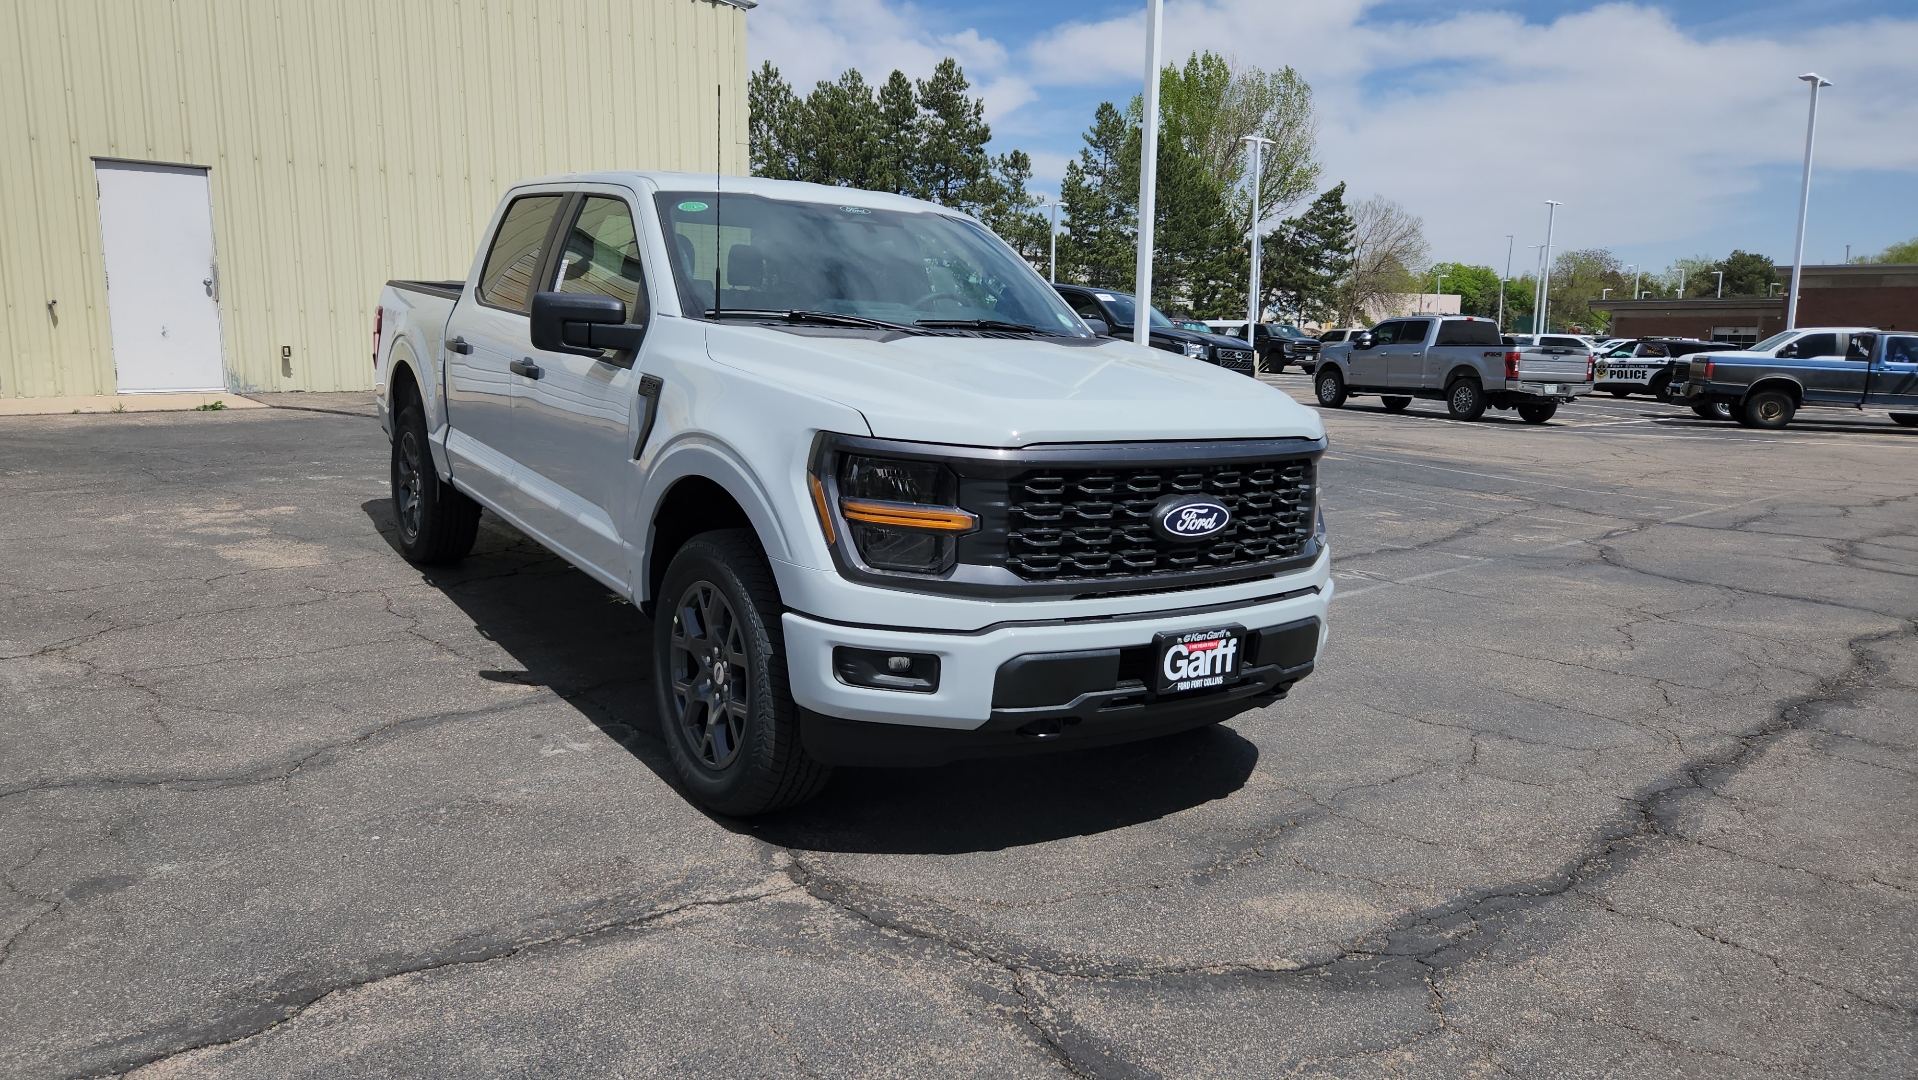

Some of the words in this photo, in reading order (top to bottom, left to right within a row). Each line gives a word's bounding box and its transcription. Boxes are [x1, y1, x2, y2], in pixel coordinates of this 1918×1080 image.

[1609, 369, 1648, 380] POLICE
[1177, 508, 1218, 532] Ford
[1191, 633, 1207, 642] Ken
[1207, 629, 1227, 640] Garff
[1164, 638, 1237, 681] Garff
[1177, 681, 1191, 691] FORD
[1191, 679, 1204, 689] FORT
[1203, 676, 1224, 687] COLLINS
